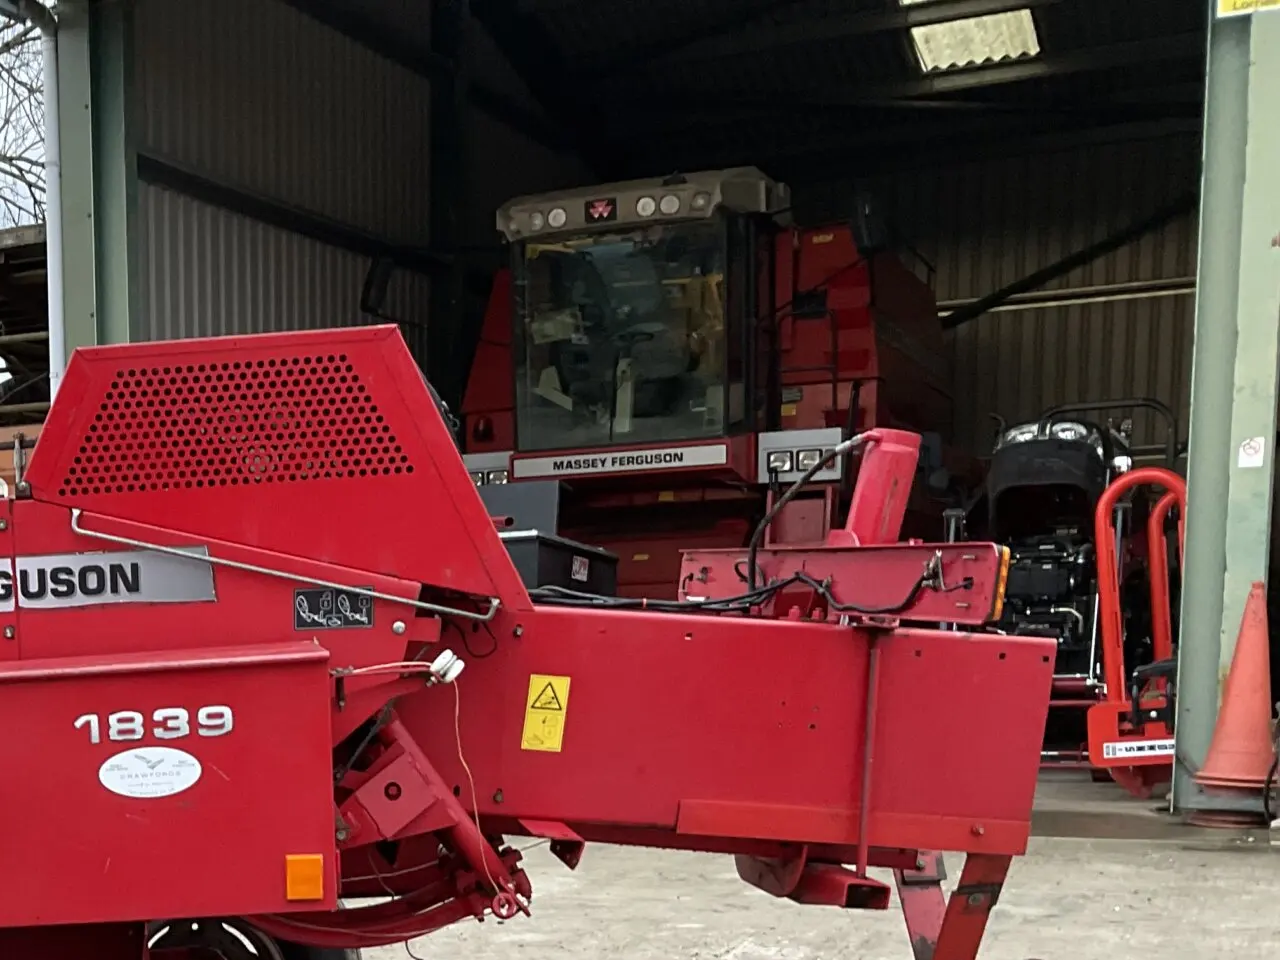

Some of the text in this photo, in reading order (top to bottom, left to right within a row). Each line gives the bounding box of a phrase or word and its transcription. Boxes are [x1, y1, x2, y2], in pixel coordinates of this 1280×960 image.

[553, 452, 683, 471] MASSEY FERGUSON
[74, 705, 233, 744] 1839
